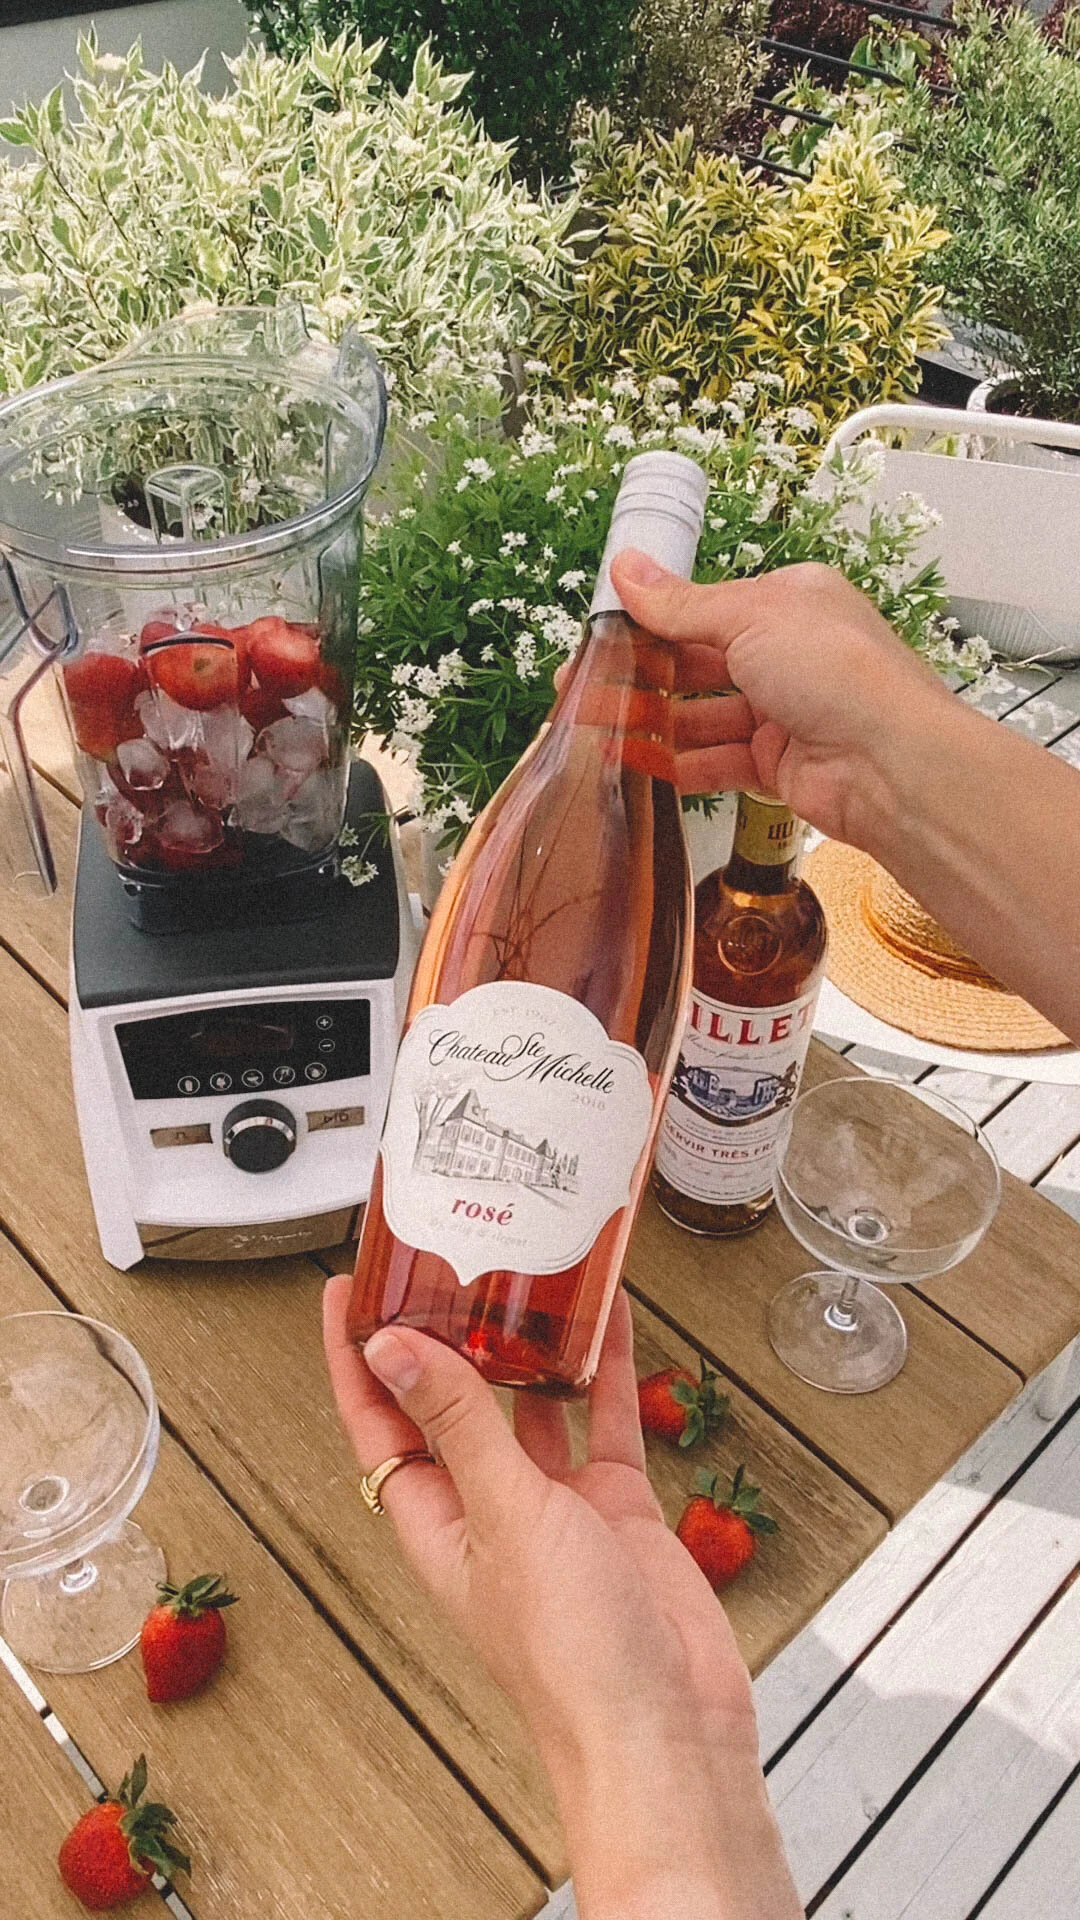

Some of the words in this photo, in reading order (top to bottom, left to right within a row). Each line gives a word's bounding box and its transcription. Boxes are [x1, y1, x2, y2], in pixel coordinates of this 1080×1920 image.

[428, 1029, 514, 1066] Chateau
[501, 1032, 545, 1057] Ste
[483, 1053, 615, 1094] Michelle
[451, 1198, 516, 1227] rosé
